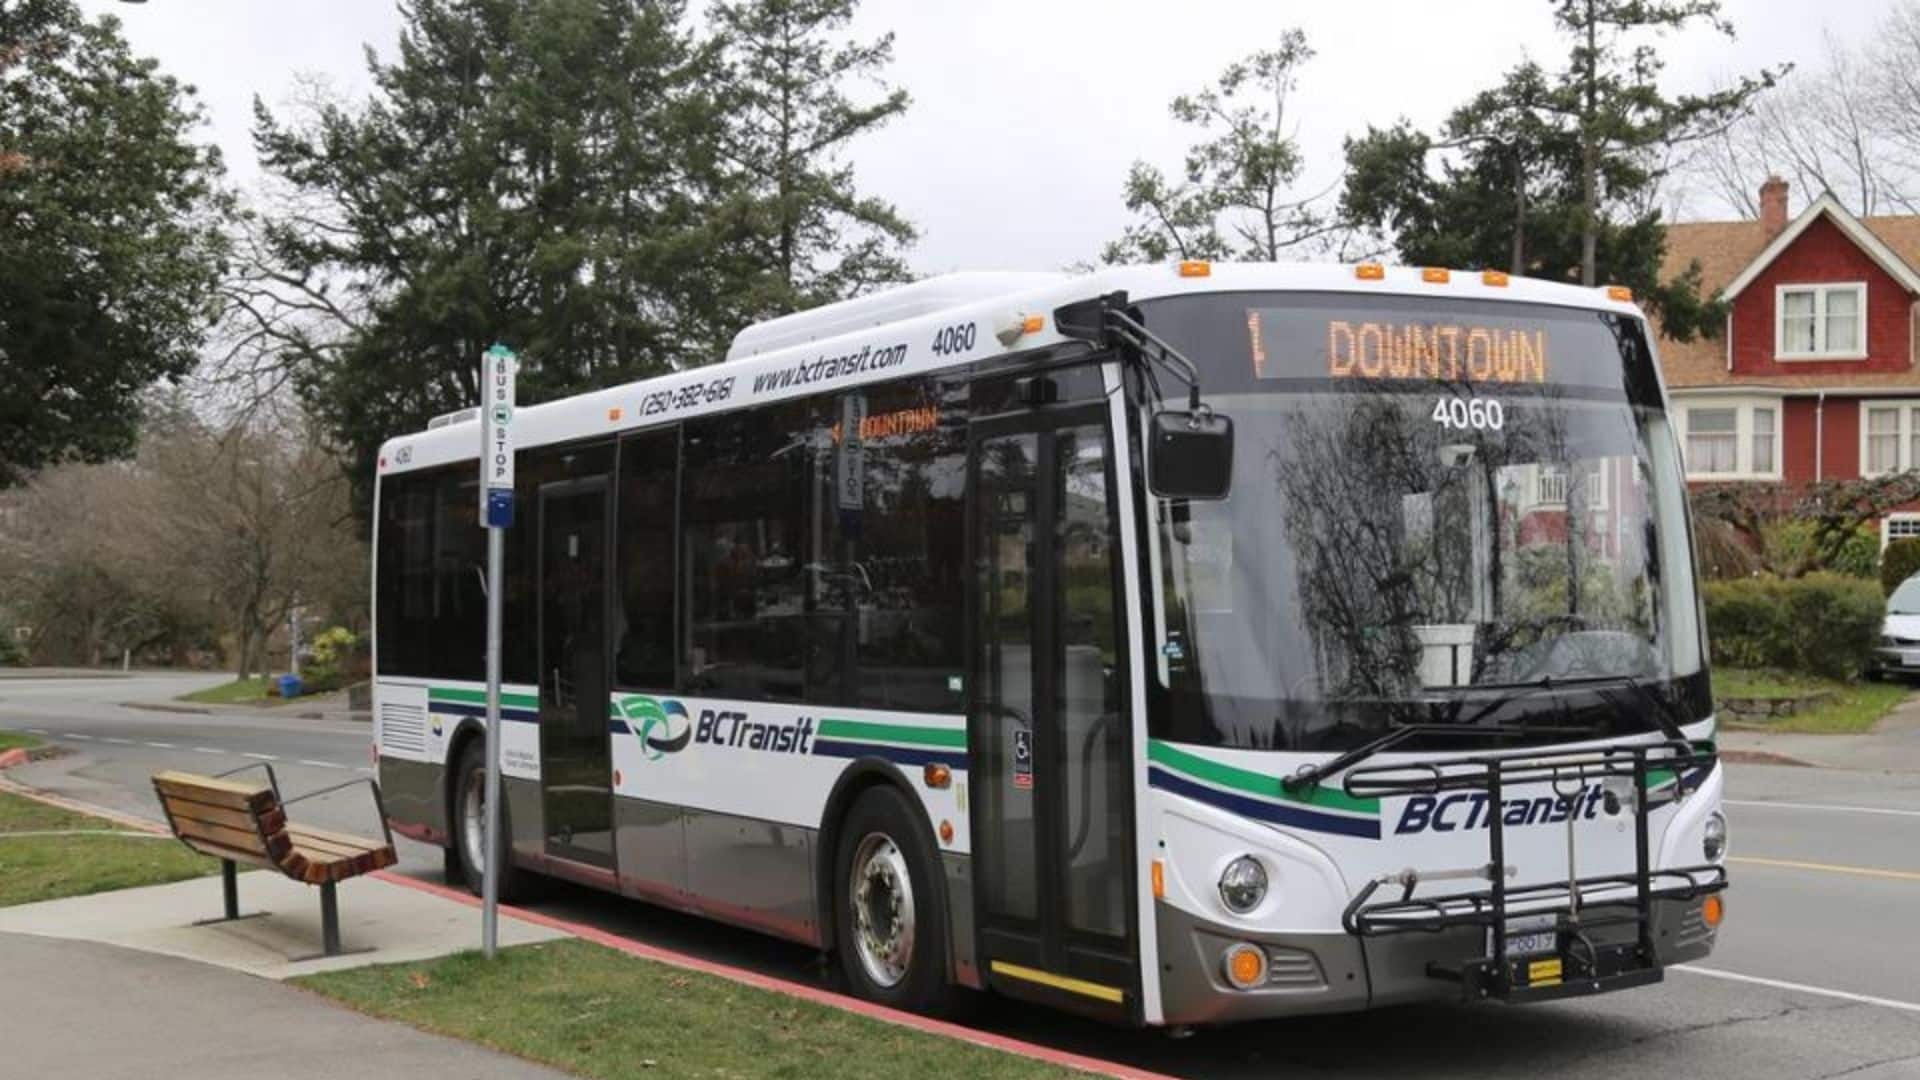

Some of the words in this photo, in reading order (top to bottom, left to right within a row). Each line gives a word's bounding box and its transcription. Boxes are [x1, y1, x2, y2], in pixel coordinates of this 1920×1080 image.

[930, 321, 977, 357] 4060
[1329, 320, 1544, 383] DOWNTOWN
[495, 358, 507, 400] BUS
[752, 343, 908, 394] www.bctransit.com
[1432, 397, 1504, 430] 4060
[495, 427, 507, 478] STOP
[695, 709, 813, 755] BCTransit
